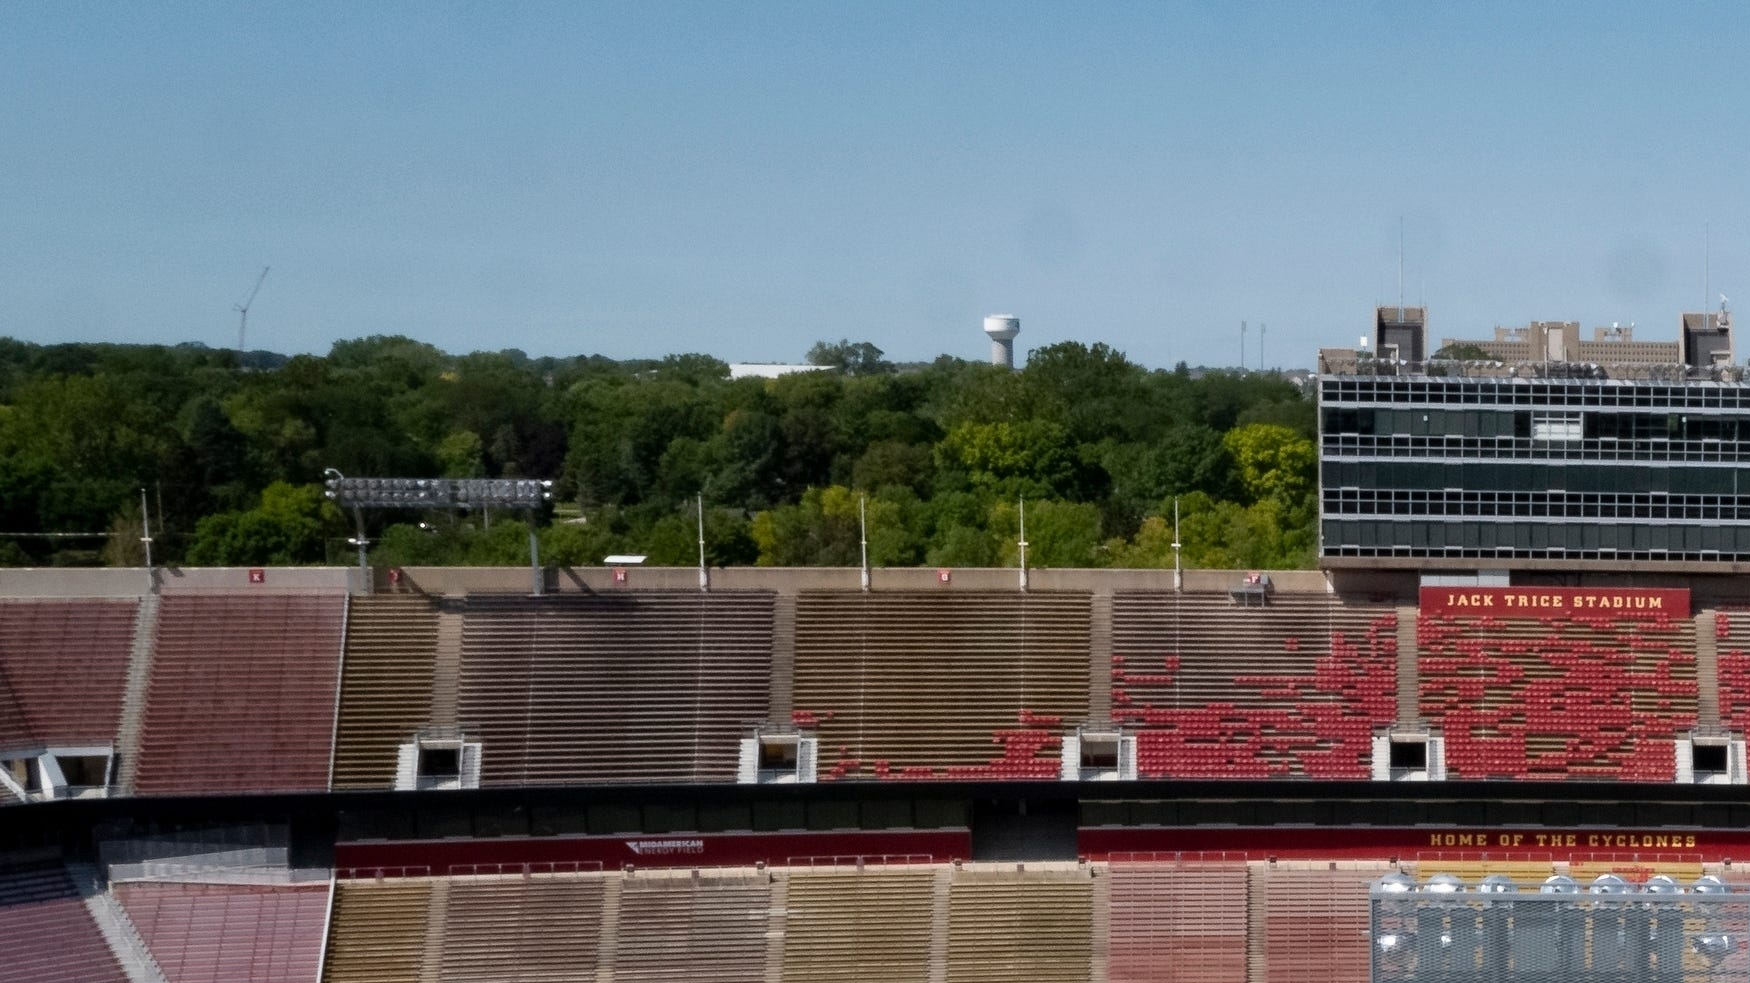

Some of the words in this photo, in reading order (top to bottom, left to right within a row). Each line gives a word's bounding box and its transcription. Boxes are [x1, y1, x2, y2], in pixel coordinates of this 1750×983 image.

[1447, 594, 1494, 607] JACK
[1504, 594, 1564, 608] TRICE
[1573, 595, 1663, 609] STADIUM
[1430, 833, 1488, 846] HOME
[1499, 833, 1524, 846] OF
[1536, 834, 1577, 847] THE
[1588, 834, 1697, 848] CYCLONES
